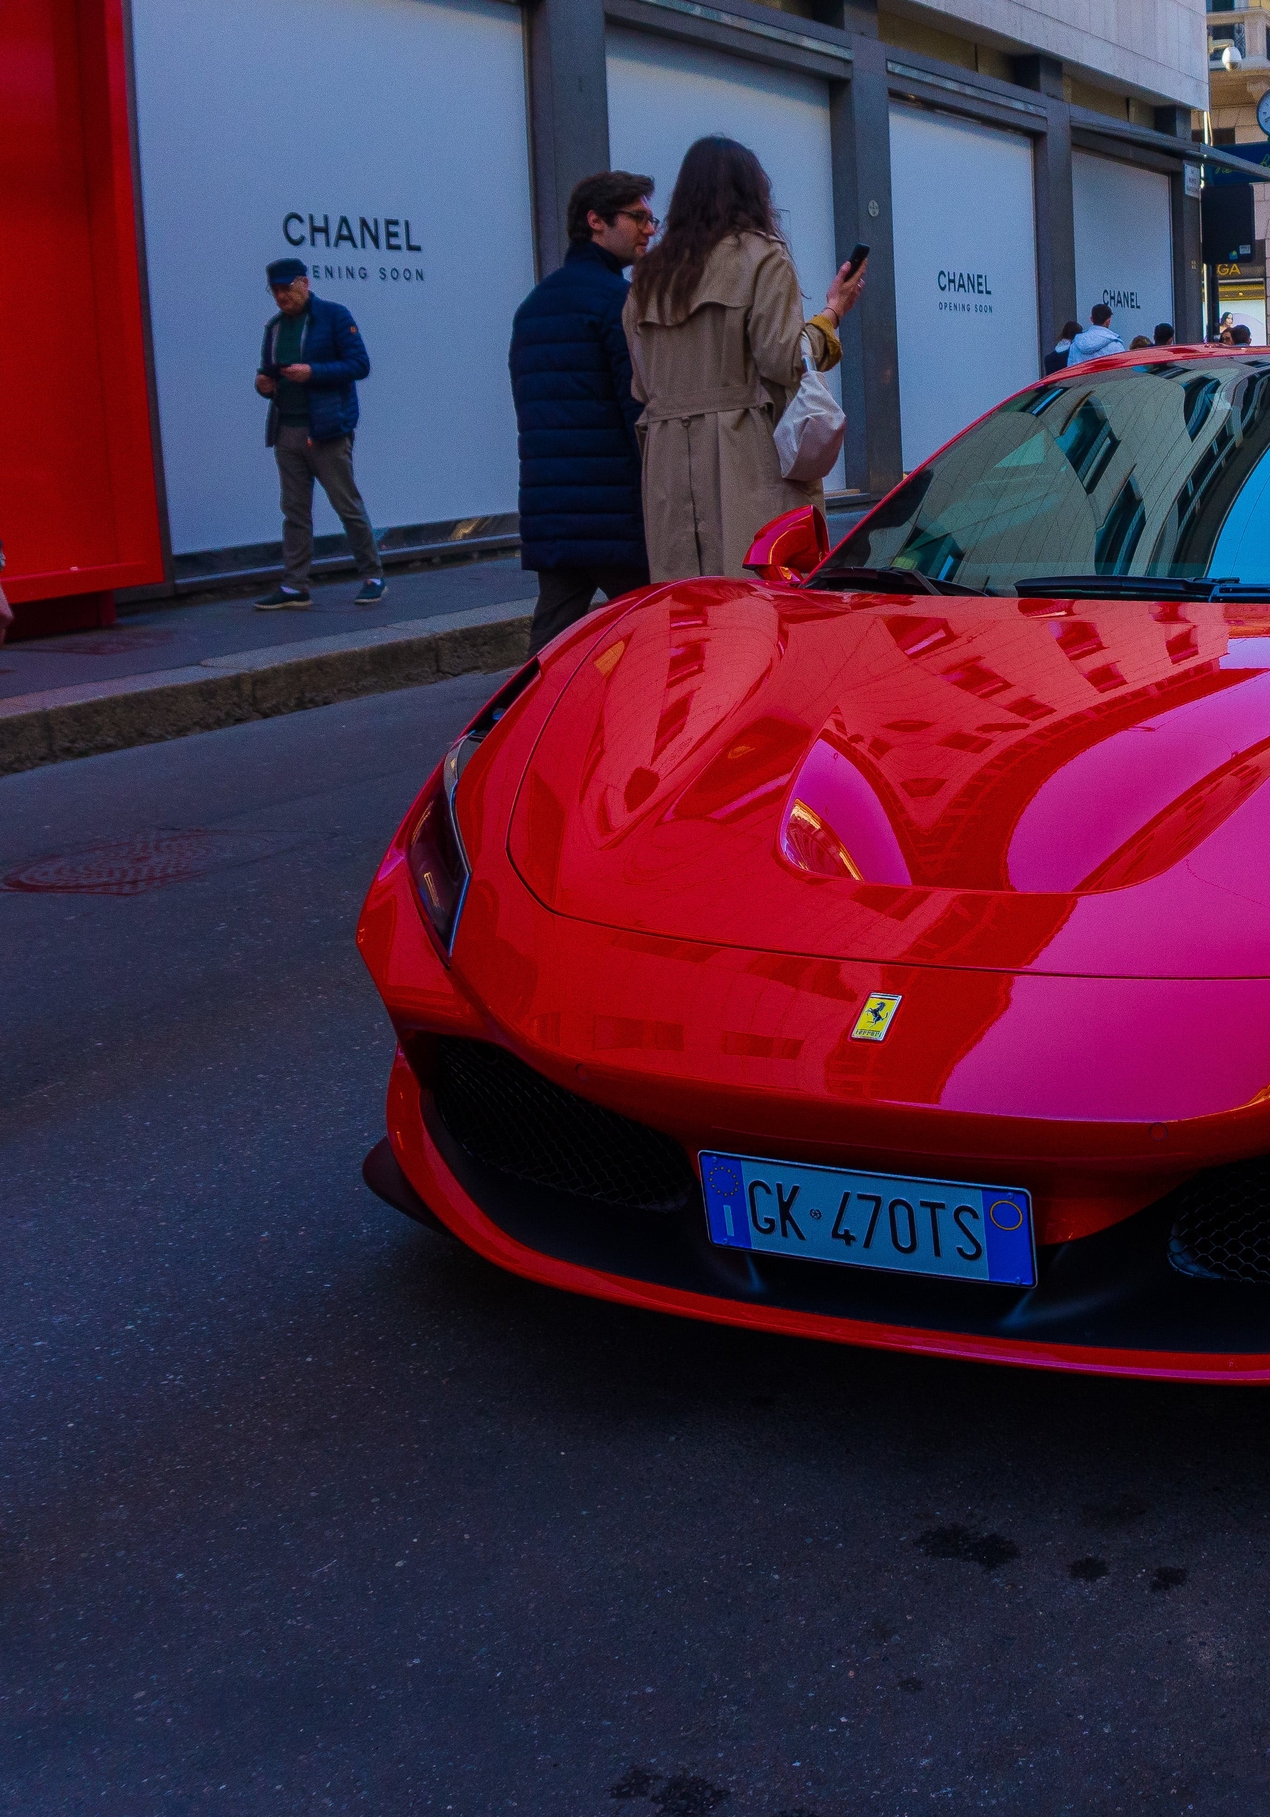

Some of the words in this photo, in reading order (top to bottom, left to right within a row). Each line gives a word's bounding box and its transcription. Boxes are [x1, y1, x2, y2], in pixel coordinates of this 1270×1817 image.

[282, 211, 422, 251] CHANEL
[312, 264, 368, 280] ENING
[379, 267, 425, 281] SOON
[937, 270, 992, 295] CHANEL
[938, 301, 971, 312] OPENING
[974, 304, 993, 313] SOON
[1102, 289, 1141, 309] CHANEL
[748, 1179, 806, 1241] GK
